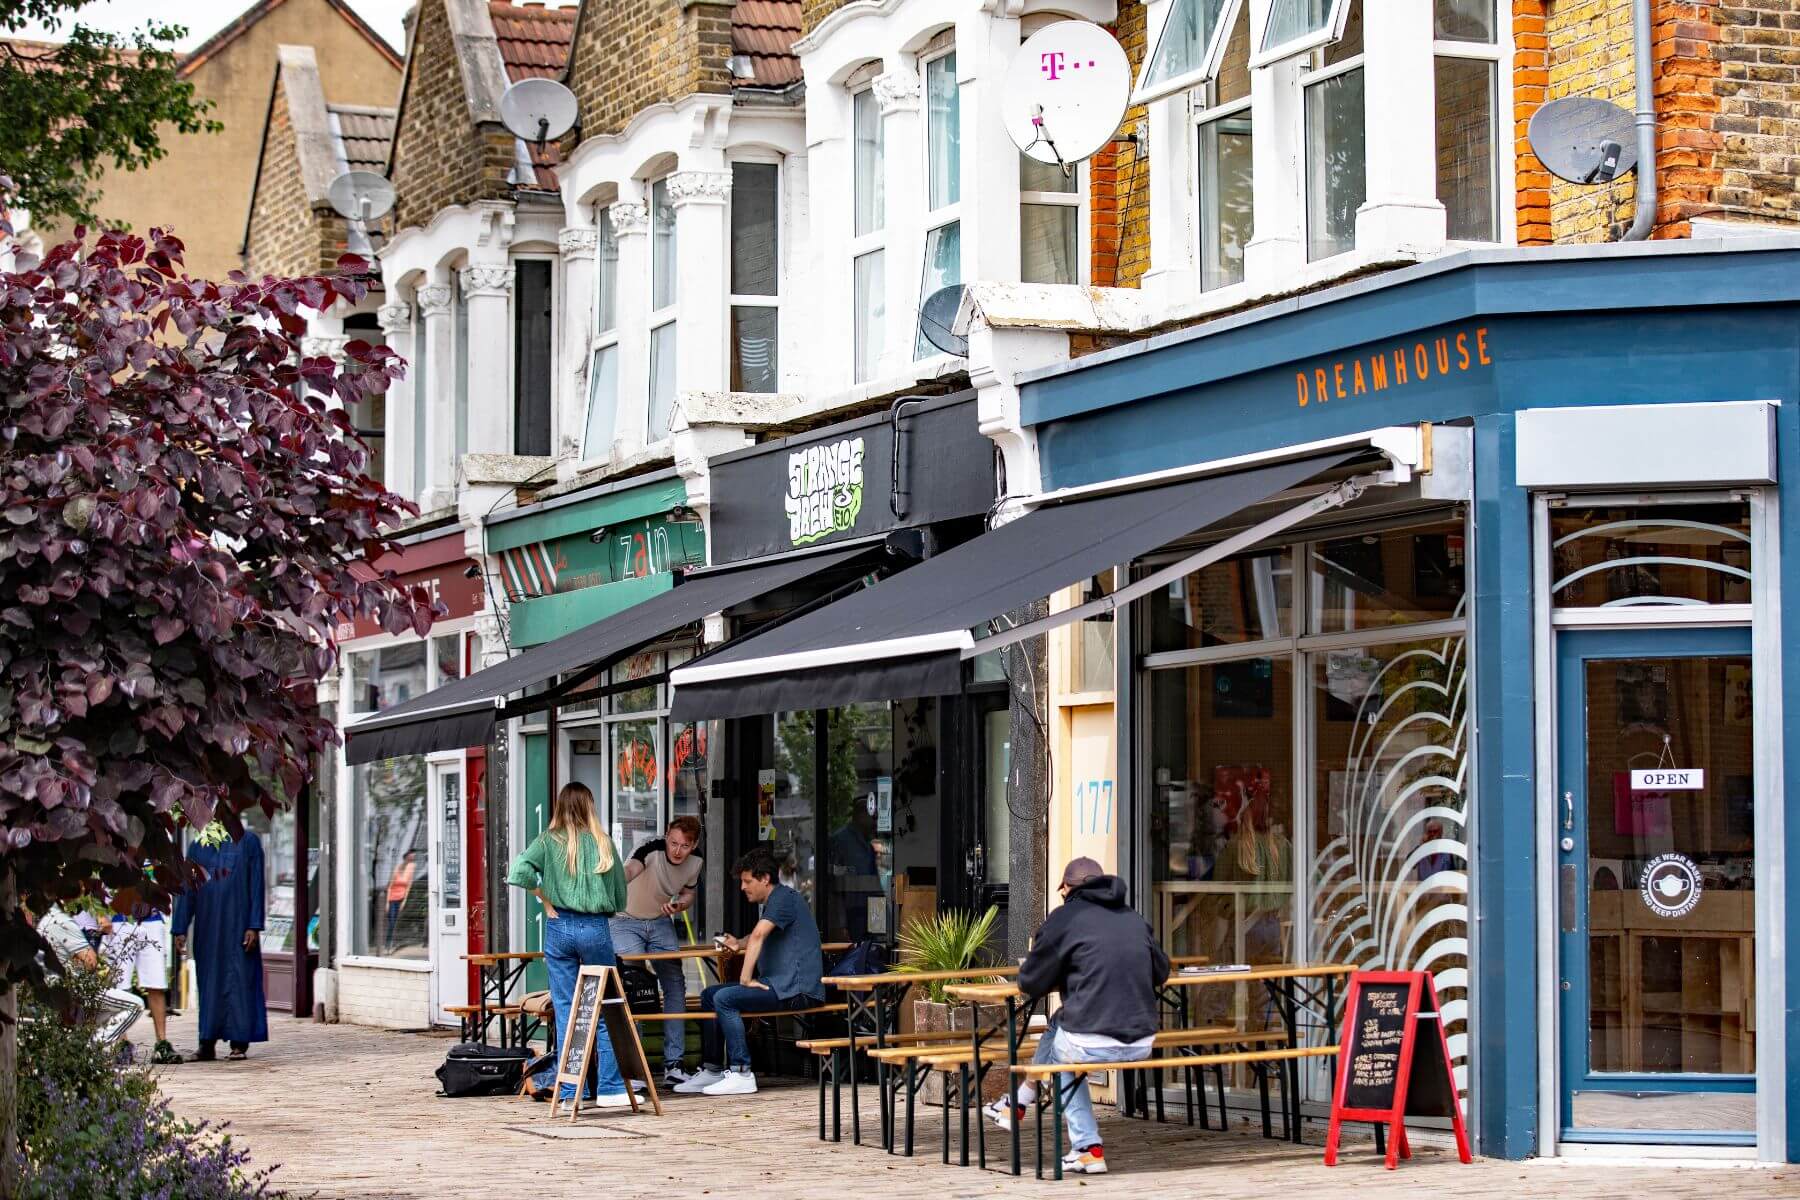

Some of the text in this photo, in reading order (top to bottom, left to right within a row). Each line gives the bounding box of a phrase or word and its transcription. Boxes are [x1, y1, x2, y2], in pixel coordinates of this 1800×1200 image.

[1296, 327, 1491, 407] DREAMHOUSE
[788, 438, 864, 499] STRANGE
[785, 490, 835, 542] BREW
[1643, 773, 1690, 785] OPEN
[1076, 780, 1112, 834] 177
[1640, 853, 1702, 883] PLEASE WEAR MASK
[1641, 887, 1702, 918] AND KEEP DISTANCE
